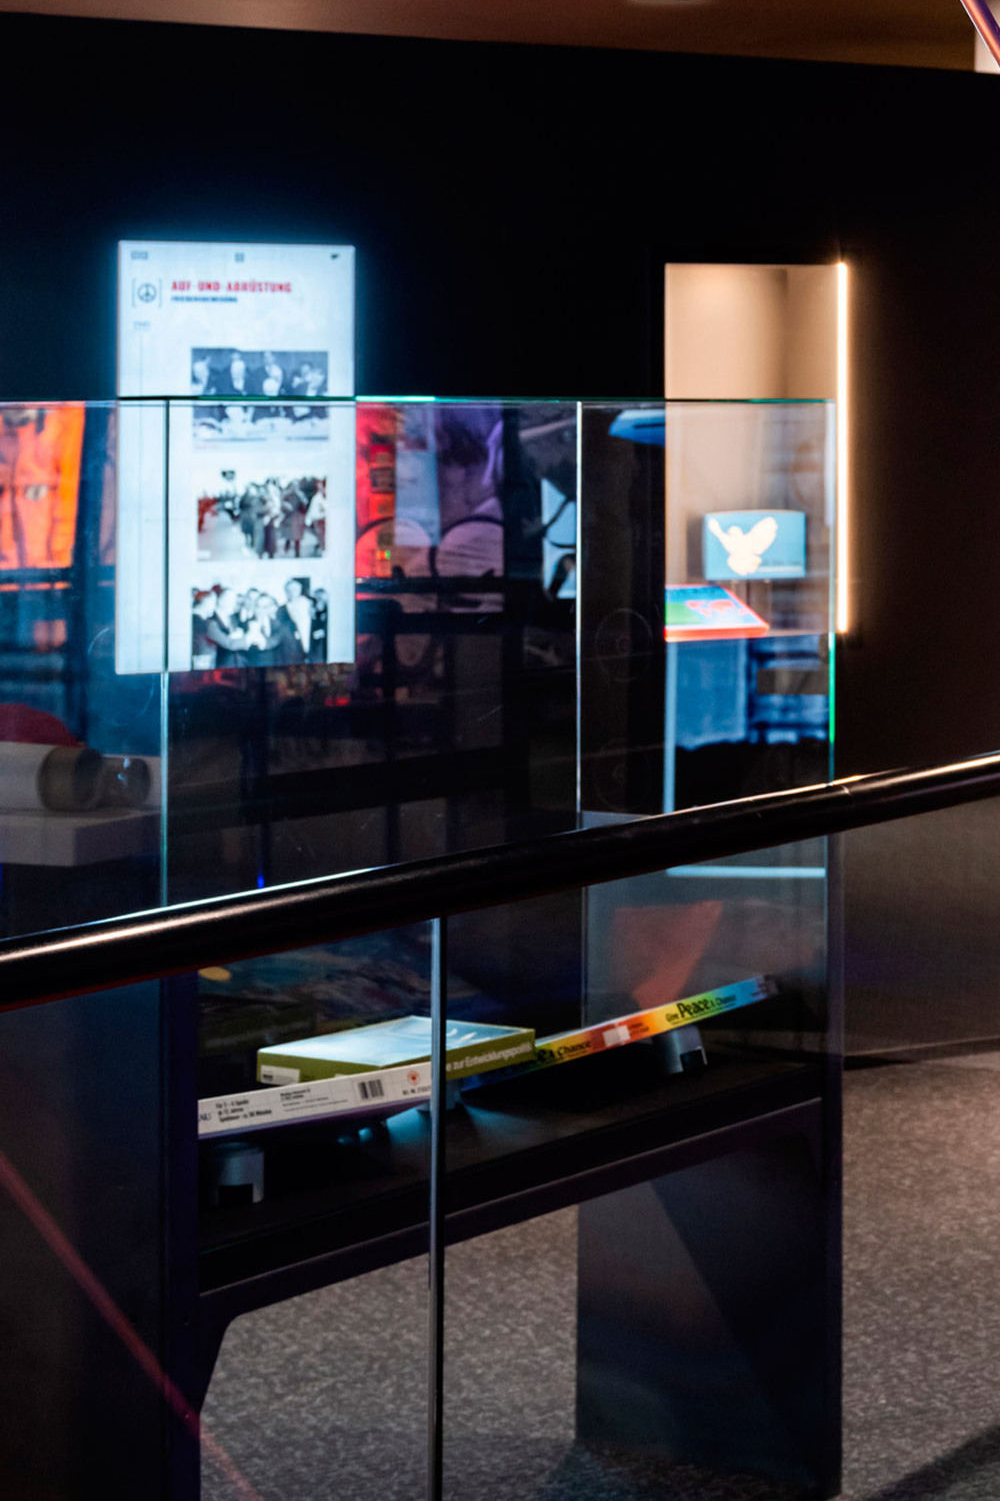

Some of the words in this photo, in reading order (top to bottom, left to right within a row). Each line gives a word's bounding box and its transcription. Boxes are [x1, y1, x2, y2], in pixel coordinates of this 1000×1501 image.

[197, 280, 221, 292] UND
[226, 278, 292, 294] ABRÜSTUNG
[676, 998, 711, 1019] Peace
[558, 1040, 591, 1058] Chance
[453, 1061, 465, 1071] zur
